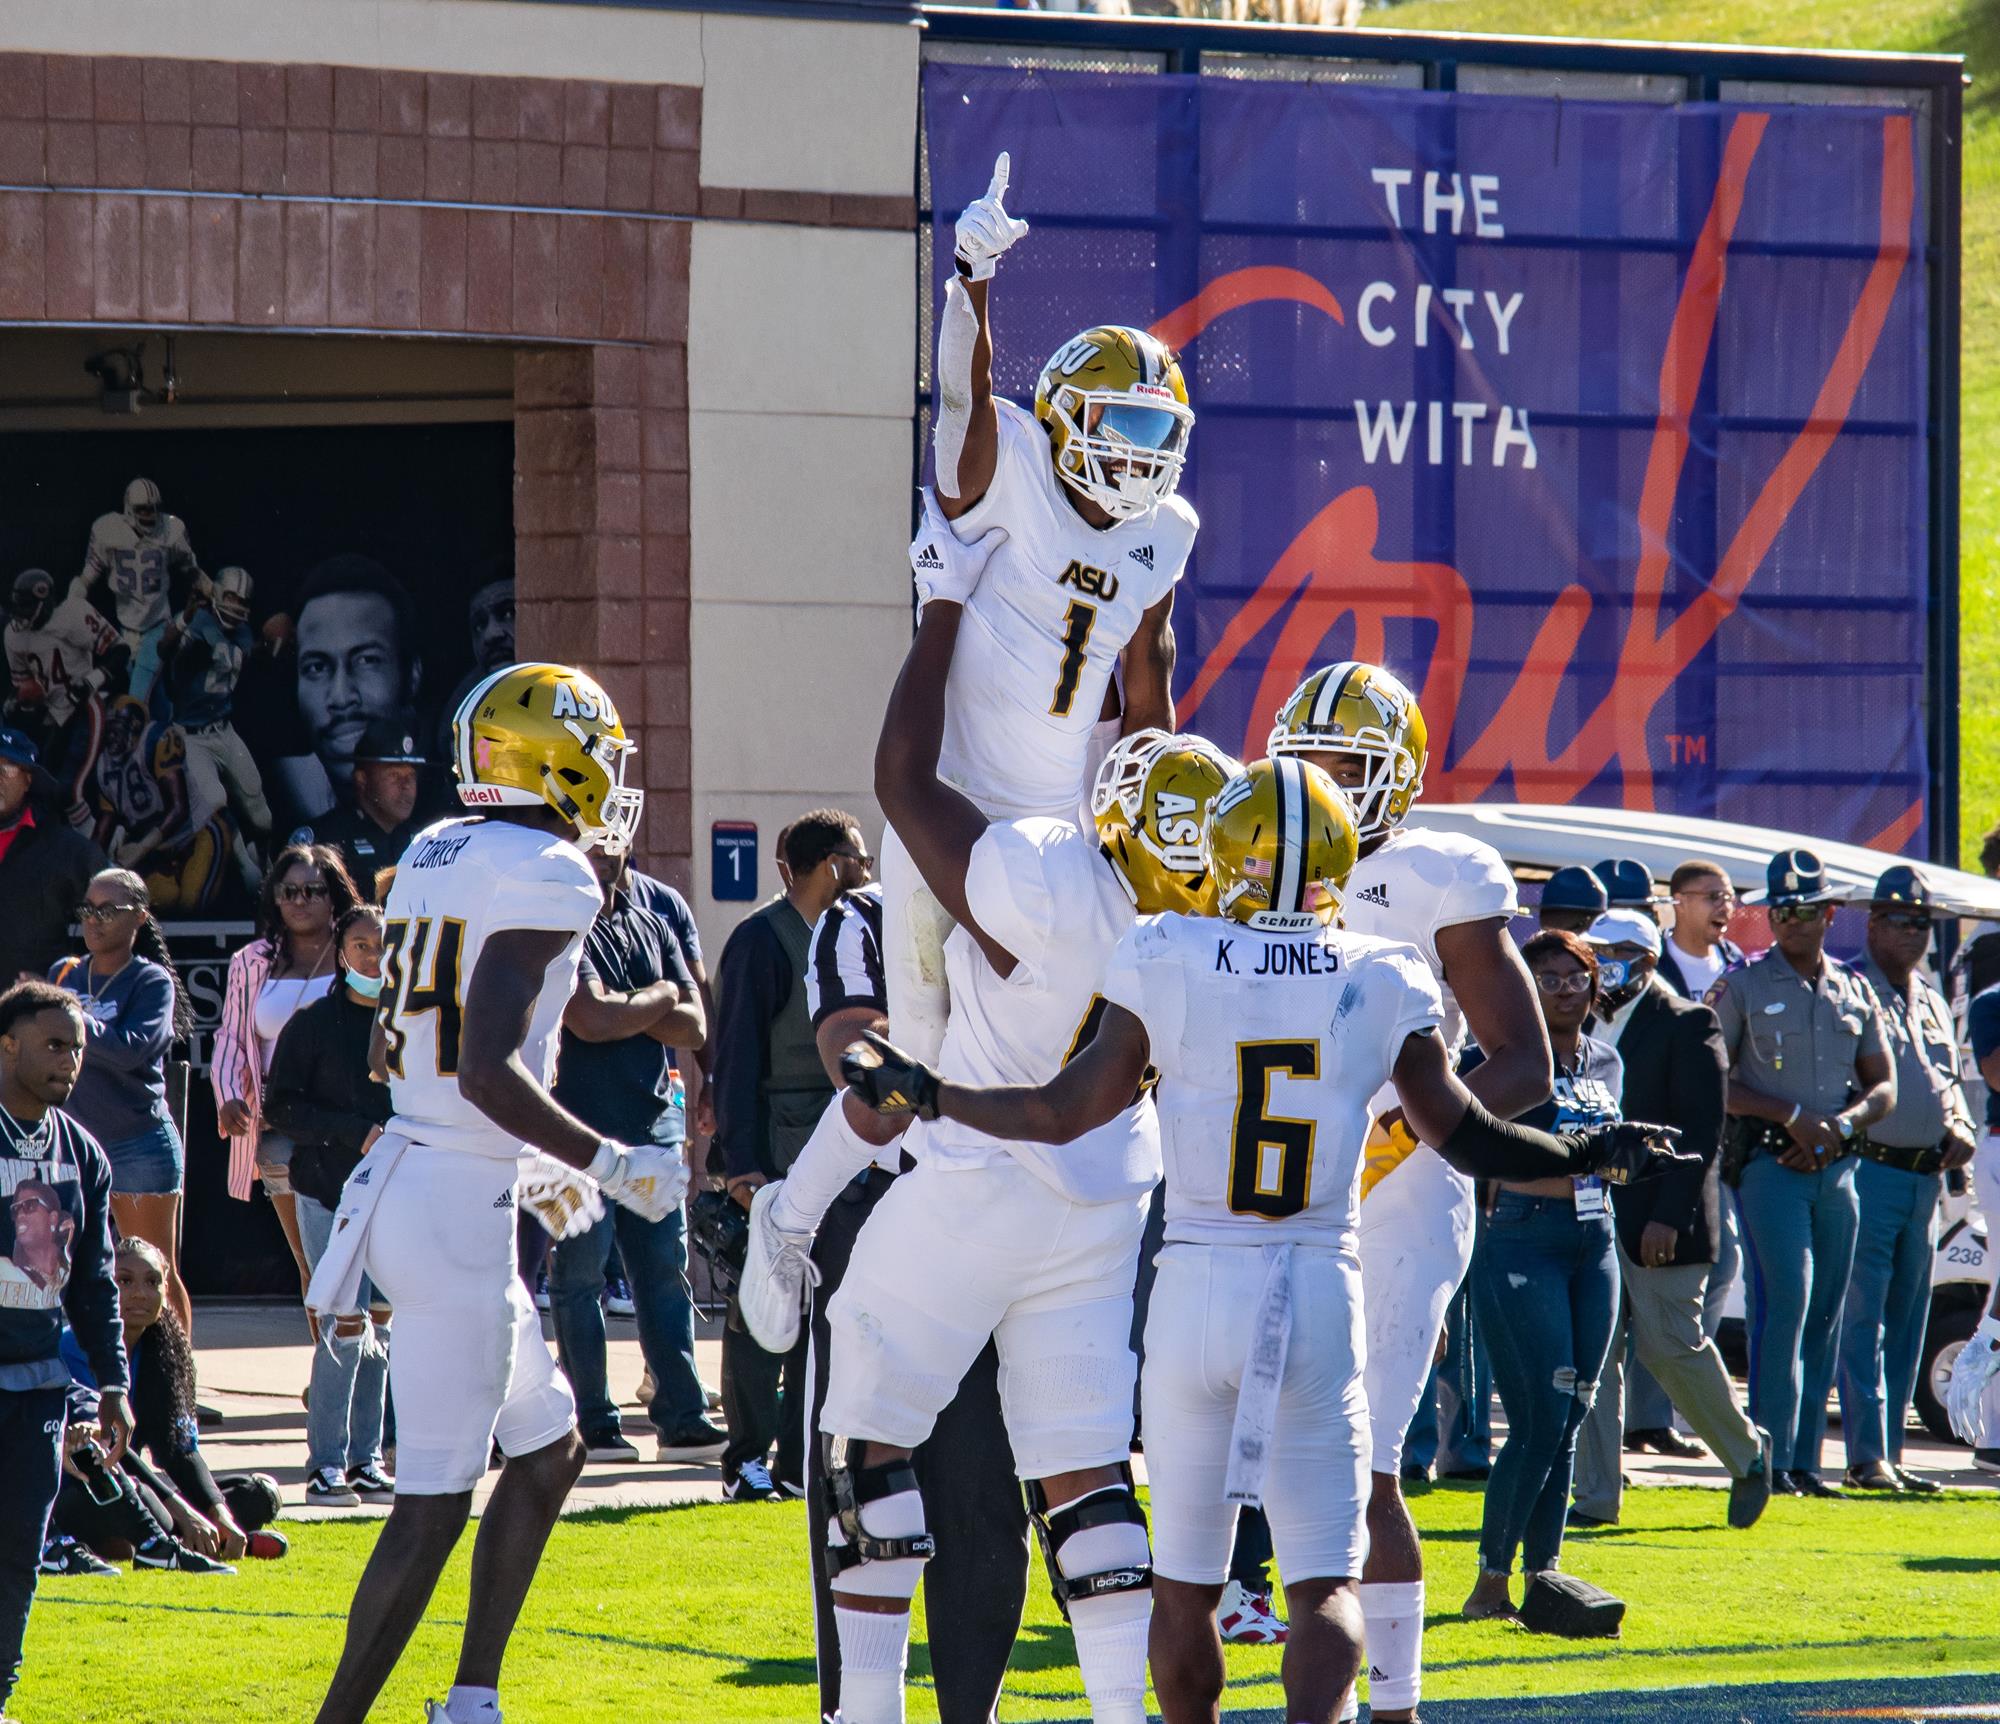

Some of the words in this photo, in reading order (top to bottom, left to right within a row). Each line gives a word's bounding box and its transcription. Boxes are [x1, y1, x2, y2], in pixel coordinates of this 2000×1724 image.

[1371, 168, 1505, 238] THE
[1357, 281, 1524, 355] CITY
[1048, 337, 1101, 376] SU
[1354, 399, 1538, 469] WITH
[114, 549, 165, 596] 52
[916, 559, 945, 570] adidas
[1056, 559, 1120, 602] ASU
[1048, 598, 1098, 716] 1
[552, 682, 616, 729] ASU
[1664, 735, 1706, 765] TM
[461, 787, 503, 804] ddell
[1156, 791, 1206, 873] ASU
[728, 847, 740, 881] 1
[1314, 866, 1322, 879] 6
[1356, 892, 1390, 908] adidas
[1257, 915, 1314, 928] schutt
[1215, 939, 1241, 975] K.
[1253, 943, 1340, 976] JONES
[1226, 1038, 1321, 1222] 6
[1947, 1246, 1984, 1267] 238
[912, 1541, 932, 1551] DON
[1096, 1573, 1144, 1588] DONJOY
